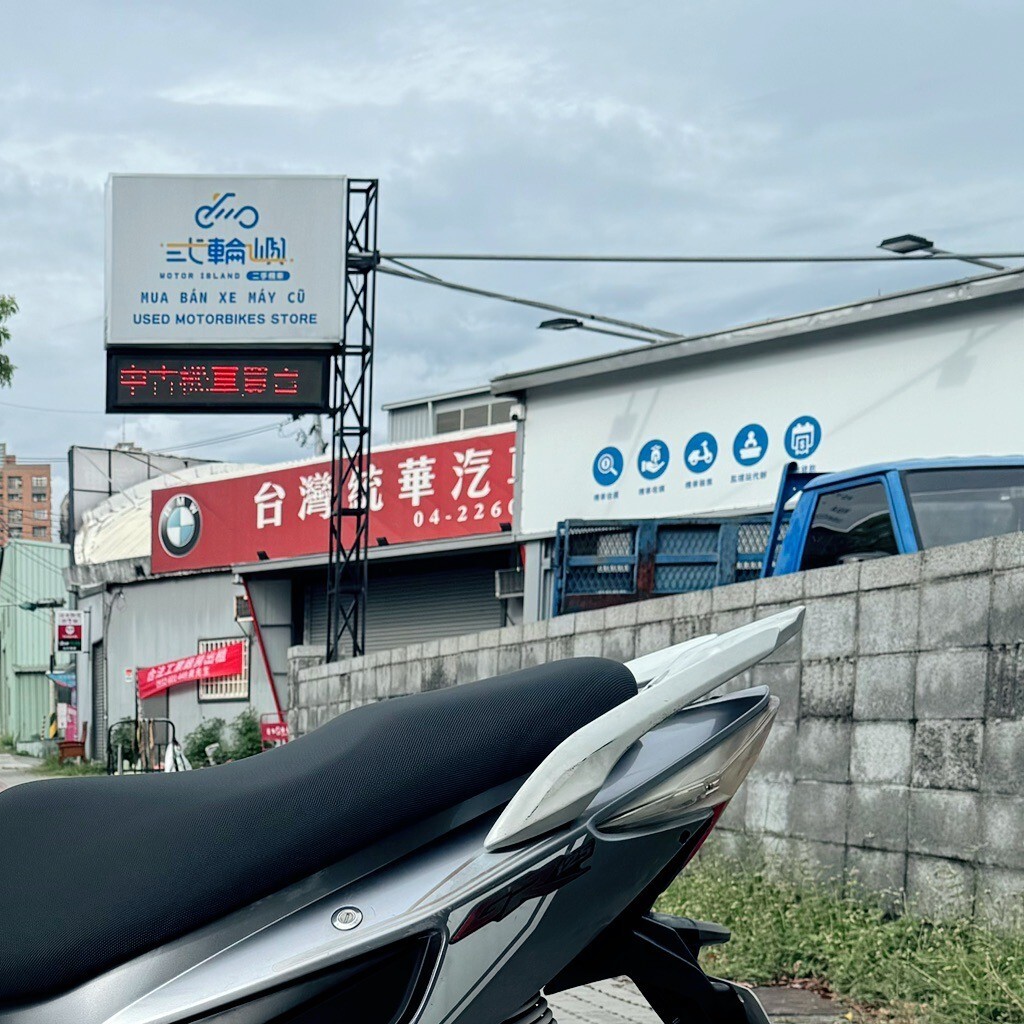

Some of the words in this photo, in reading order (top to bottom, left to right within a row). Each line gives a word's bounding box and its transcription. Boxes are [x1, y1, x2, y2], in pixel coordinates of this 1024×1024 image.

[159, 272, 194, 280] MOTOR
[199, 272, 241, 280] ISLAND
[140, 291, 169, 304] MUA
[180, 288, 208, 304] BÁN
[219, 291, 237, 304] XE
[248, 288, 276, 304] MÁY
[287, 288, 306, 304] CŨ
[133, 313, 171, 325] USED
[175, 313, 266, 325] MOTORBIKES
[270, 313, 318, 325] STORE
[253, 446, 517, 530] 台灣統華汽
